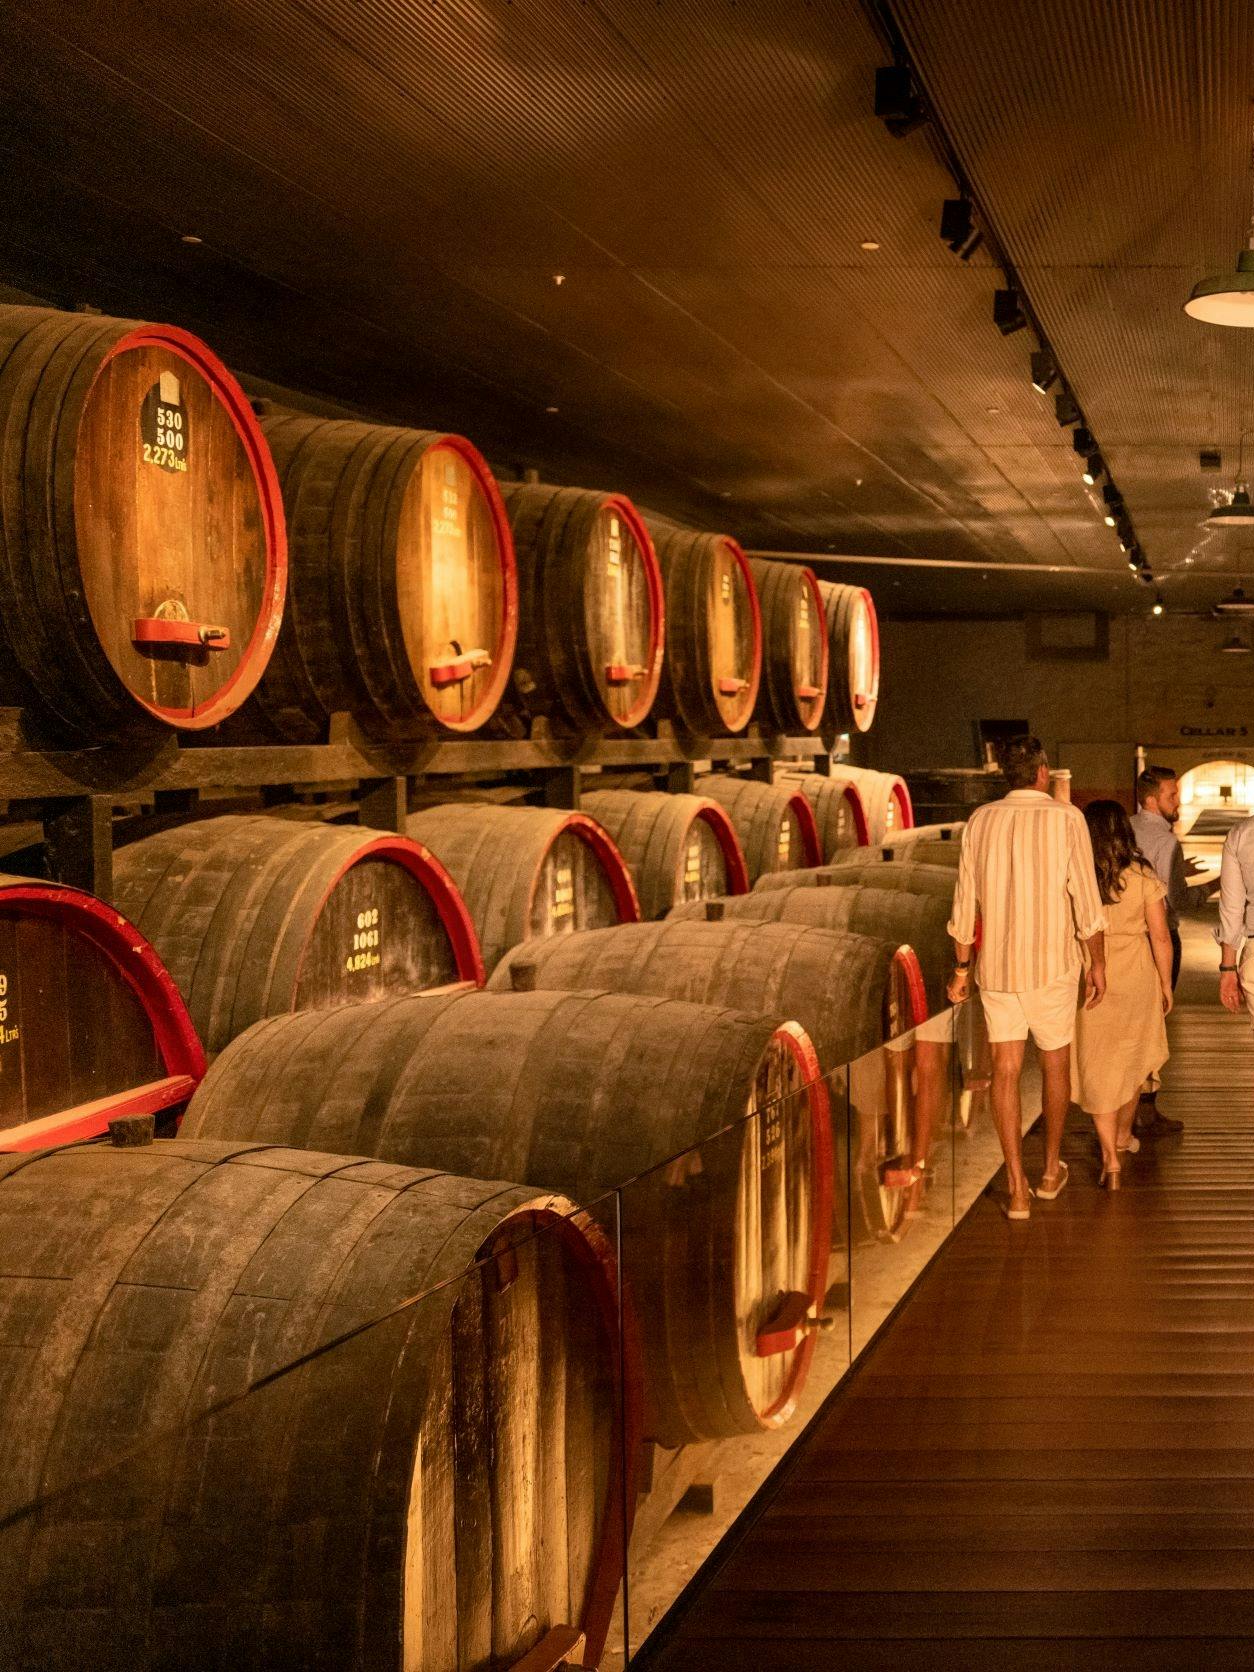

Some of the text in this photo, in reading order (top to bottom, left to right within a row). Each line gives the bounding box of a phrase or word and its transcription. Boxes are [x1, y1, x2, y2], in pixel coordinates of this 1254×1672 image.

[157, 407, 182, 429] 530
[157, 428, 183, 450] 500
[1180, 727, 1236, 736] CELLAR
[358, 909, 378, 929] 602
[354, 930, 378, 950] 1061
